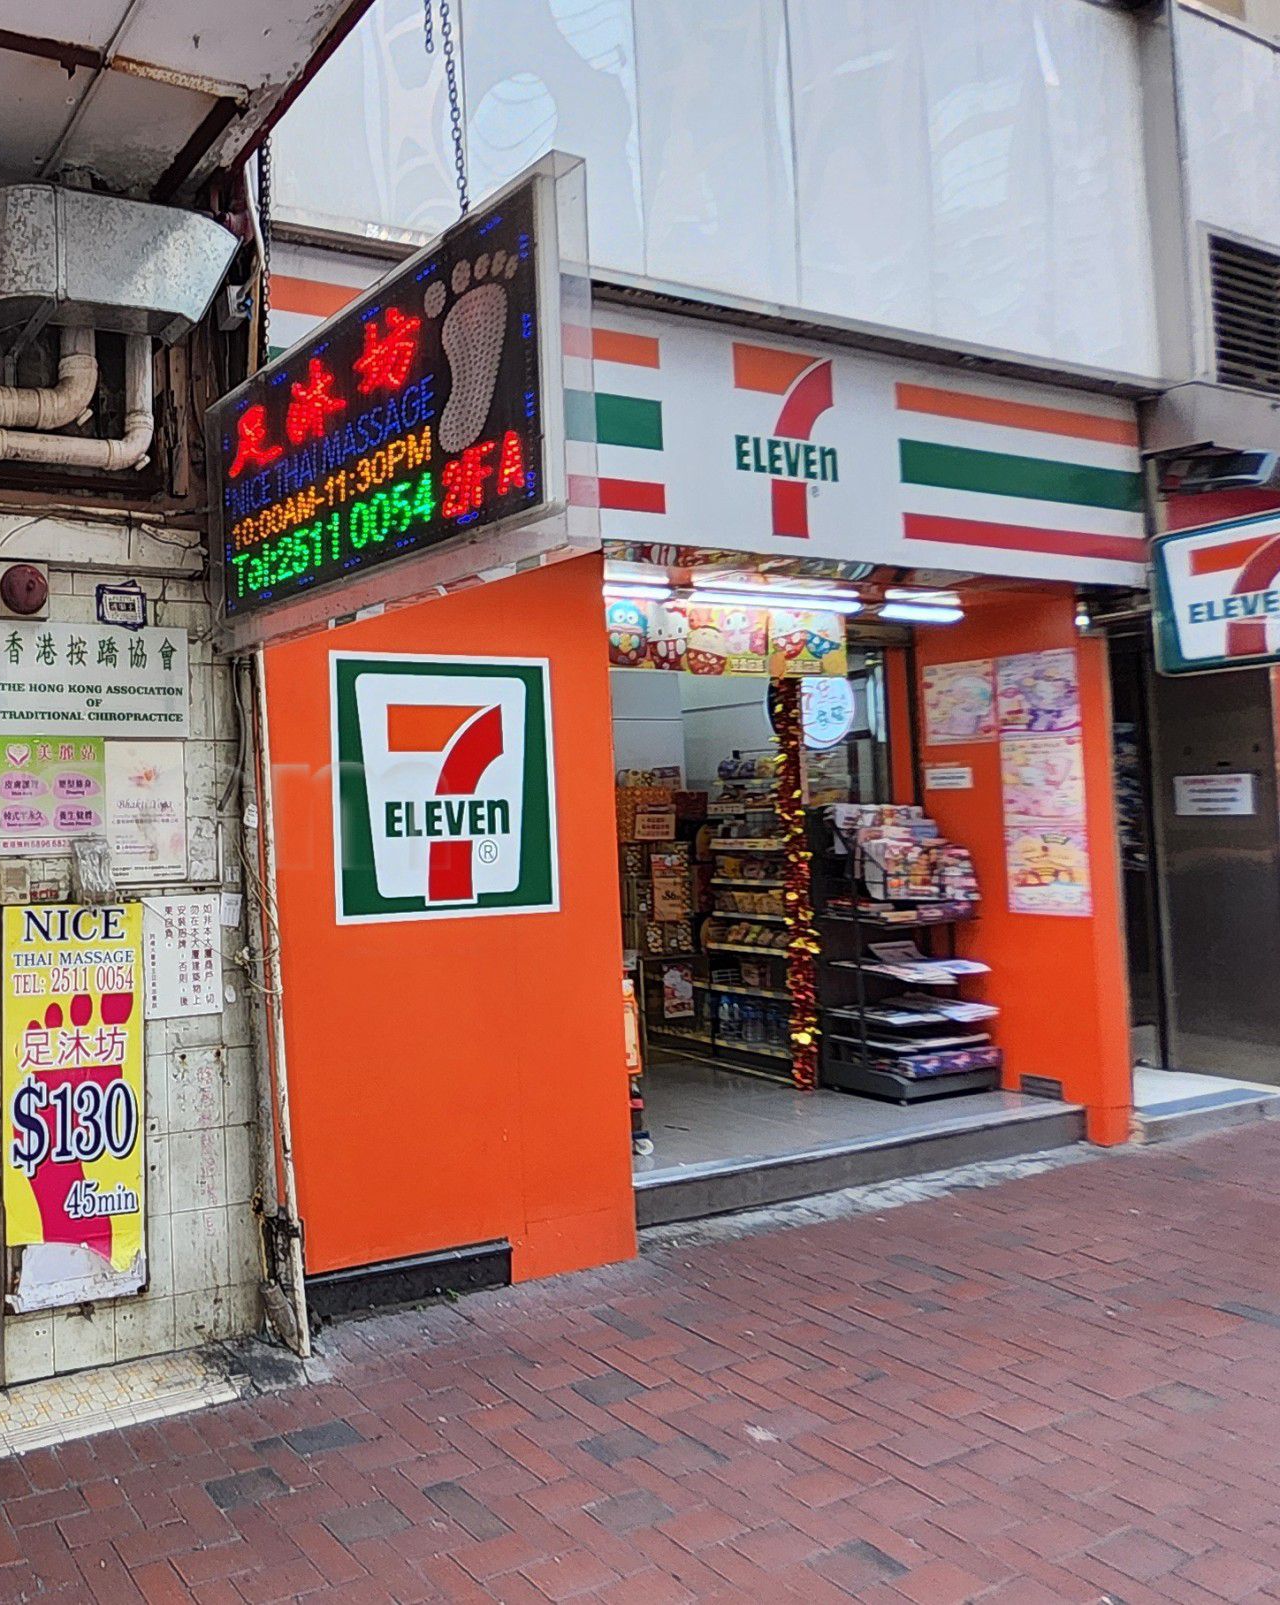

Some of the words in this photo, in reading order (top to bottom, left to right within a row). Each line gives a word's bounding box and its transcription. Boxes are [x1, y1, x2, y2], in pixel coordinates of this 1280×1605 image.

[231, 468, 273, 522] NICE
[274, 442, 318, 498] THAI
[321, 374, 436, 474] MASSAGE
[350, 472, 437, 549] 0054
[1188, 590, 1280, 625] ELEVE
[3, 629, 178, 672] 香港按蹻協會
[28, 683, 64, 694] HONG
[68, 684, 103, 694] KONG
[106, 684, 183, 696] ASSOCIATION
[86, 698, 103, 708] OF
[0, 710, 84, 721] TRADITIONAL
[87, 711, 183, 723] CHIROPRACTICE
[23, 907, 125, 942] NICE
[14, 953, 52, 967] THAI
[59, 951, 134, 965] MASSAGE
[13, 973, 45, 994] TEL:
[51, 967, 89, 992] 2511
[96, 966, 134, 991] 0054
[21, 1026, 128, 1068] 足沐坊
[12, 1076, 134, 1173] $130
[66, 1181, 137, 1217] 45min
